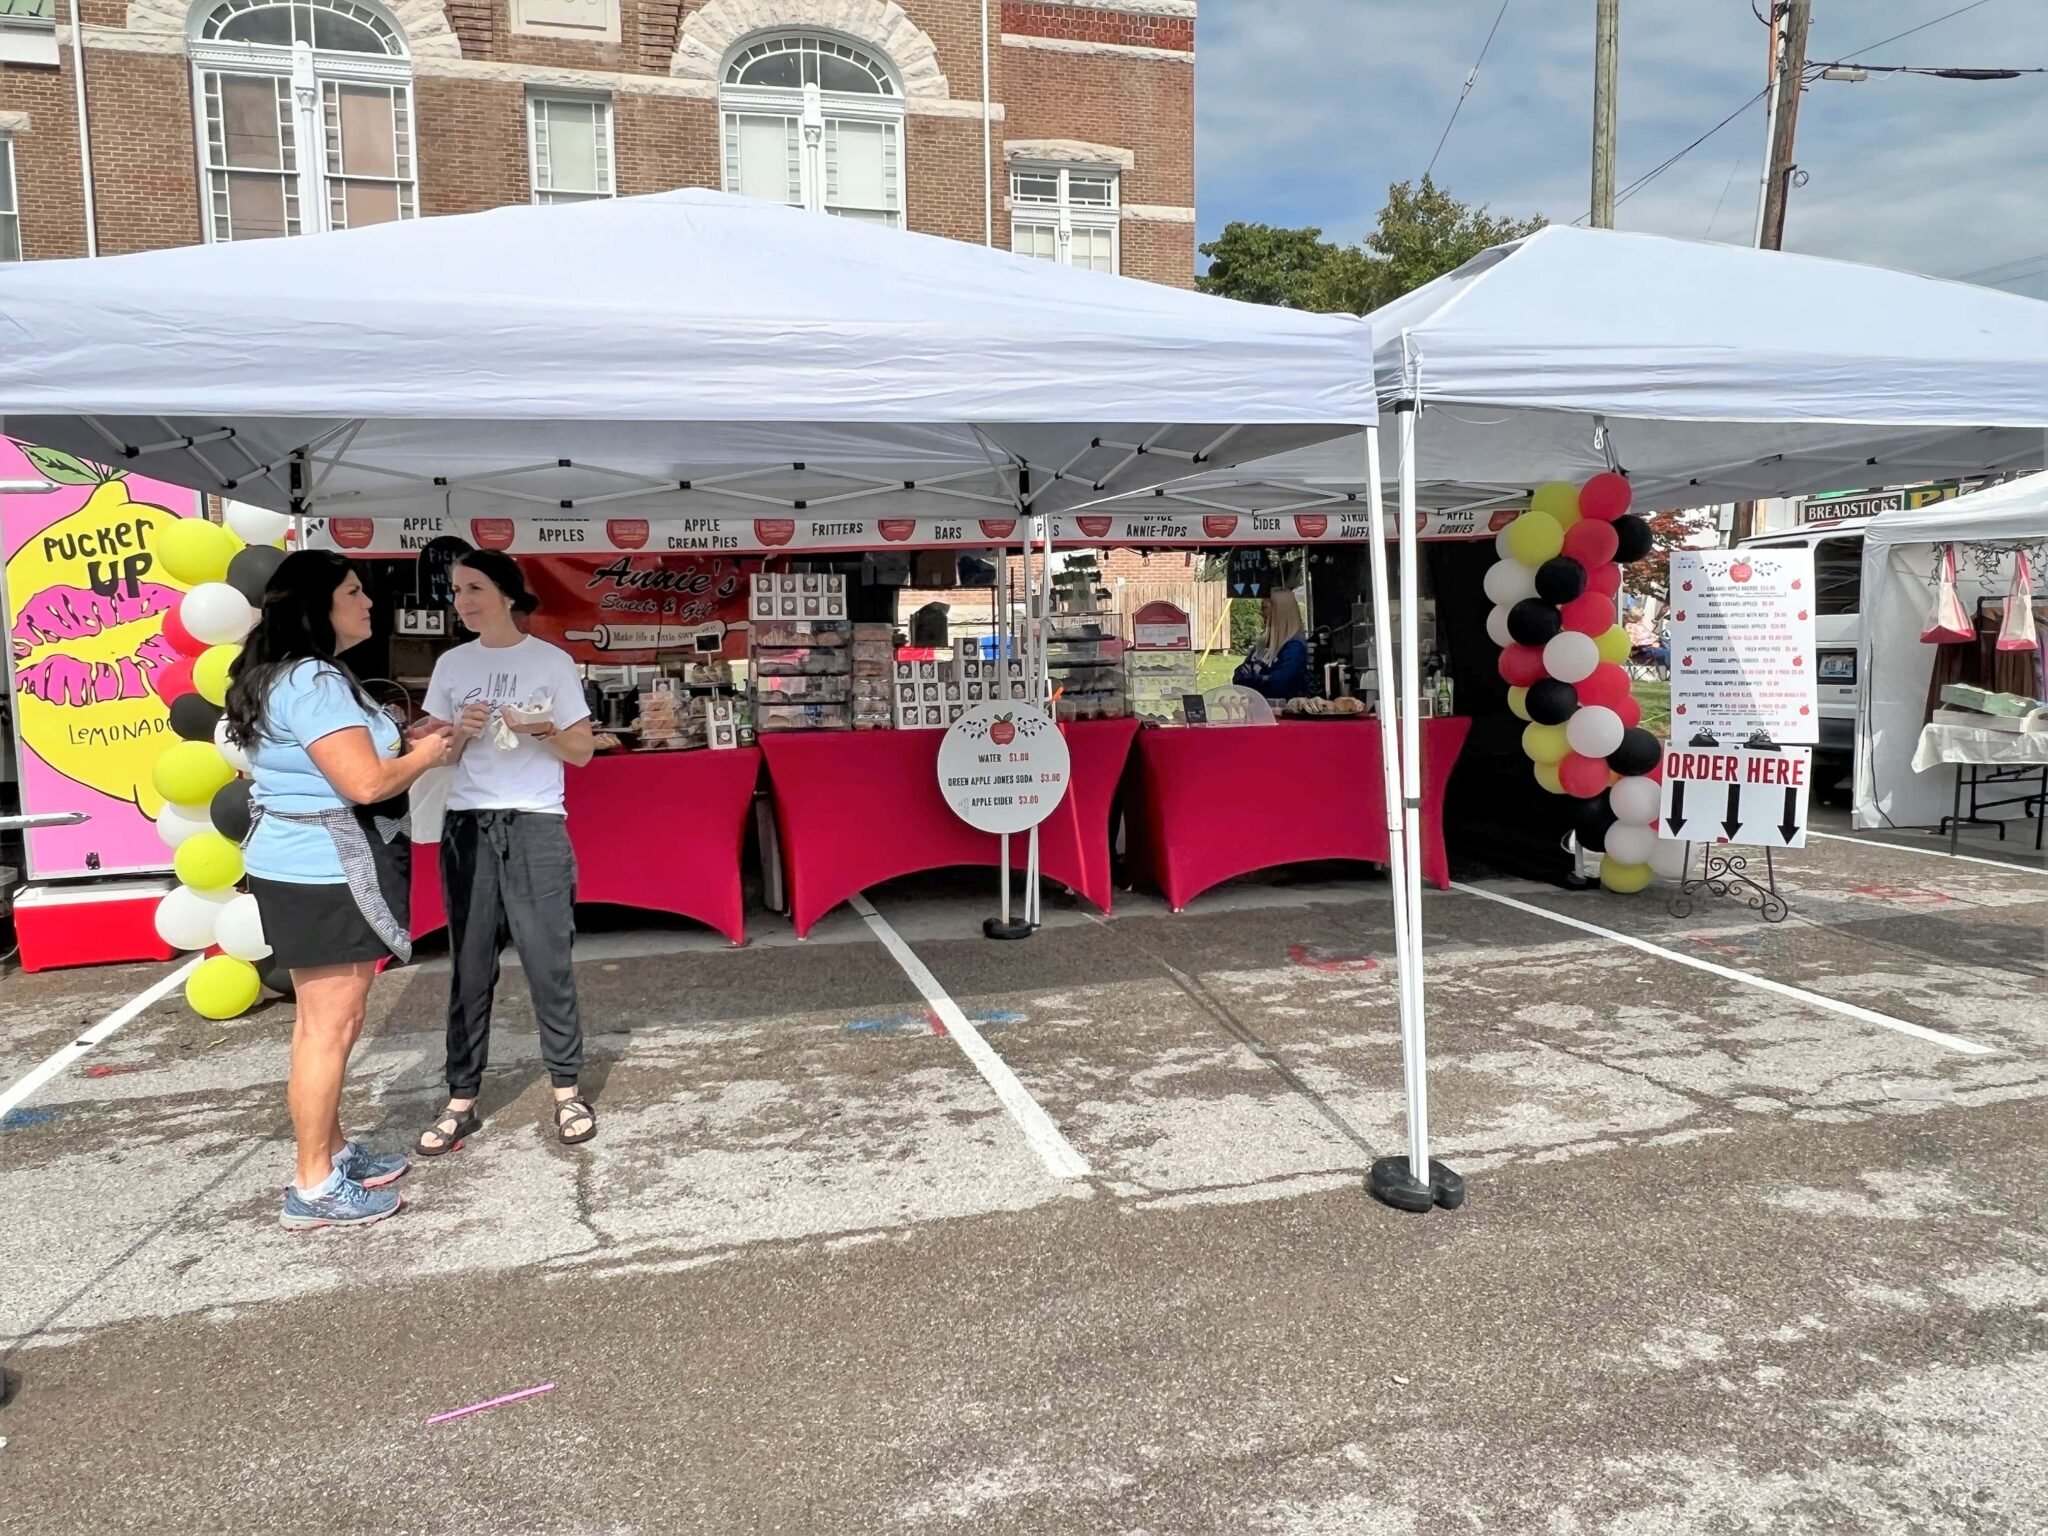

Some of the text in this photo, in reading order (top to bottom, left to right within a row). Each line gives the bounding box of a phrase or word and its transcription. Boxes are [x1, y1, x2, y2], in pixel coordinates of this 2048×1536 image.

[1808, 498, 1898, 520] BREADSTICKS
[403, 517, 443, 531] APPLE
[684, 518, 720, 532] APPLE
[811, 522, 863, 536] FRITTERS
[1126, 524, 1188, 537] ANNIE-POPS
[1253, 517, 1281, 531] CIDER
[1437, 523, 1475, 534] COOKIES
[539, 527, 585, 542] APPLES
[935, 526, 962, 540] BARS
[668, 535, 738, 549] CREAM PIES
[87, 552, 153, 598] UP
[586, 556, 736, 598] Annie's
[600, 594, 657, 613] Sweets
[662, 597, 676, 614] &
[613, 632, 633, 641] Make
[978, 752, 1029, 763] WATER $1.00
[1667, 752, 1805, 786] ORDER HERE
[948, 773, 1061, 787] GREEN APPLE JONES SODA $3.00
[971, 795, 1039, 807] APPLE CIDER $3.00
